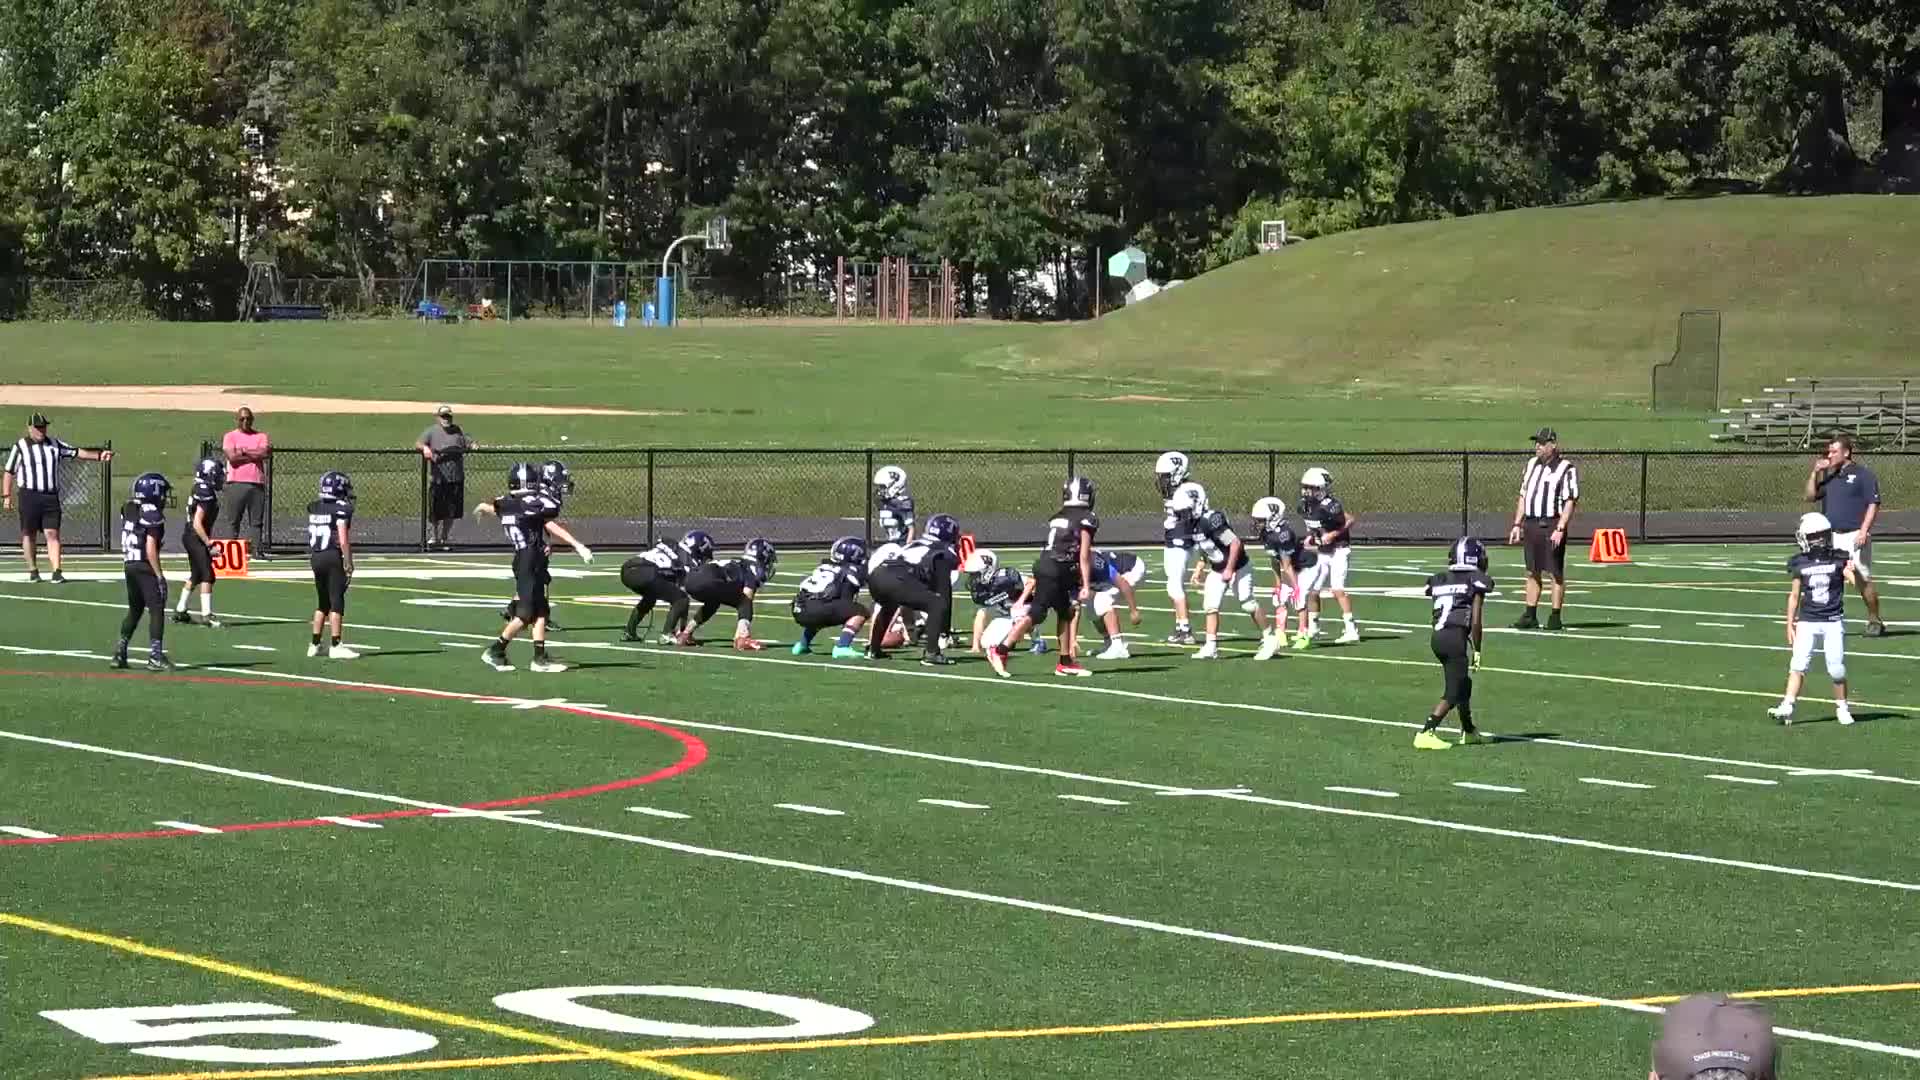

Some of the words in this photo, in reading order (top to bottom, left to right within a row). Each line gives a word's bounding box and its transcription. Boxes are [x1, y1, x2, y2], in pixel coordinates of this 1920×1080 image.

[210, 540, 243, 570] 30
[1601, 530, 1625, 557] 10
[1433, 595, 1454, 632] 7
[37, 984, 875, 1063] 50
